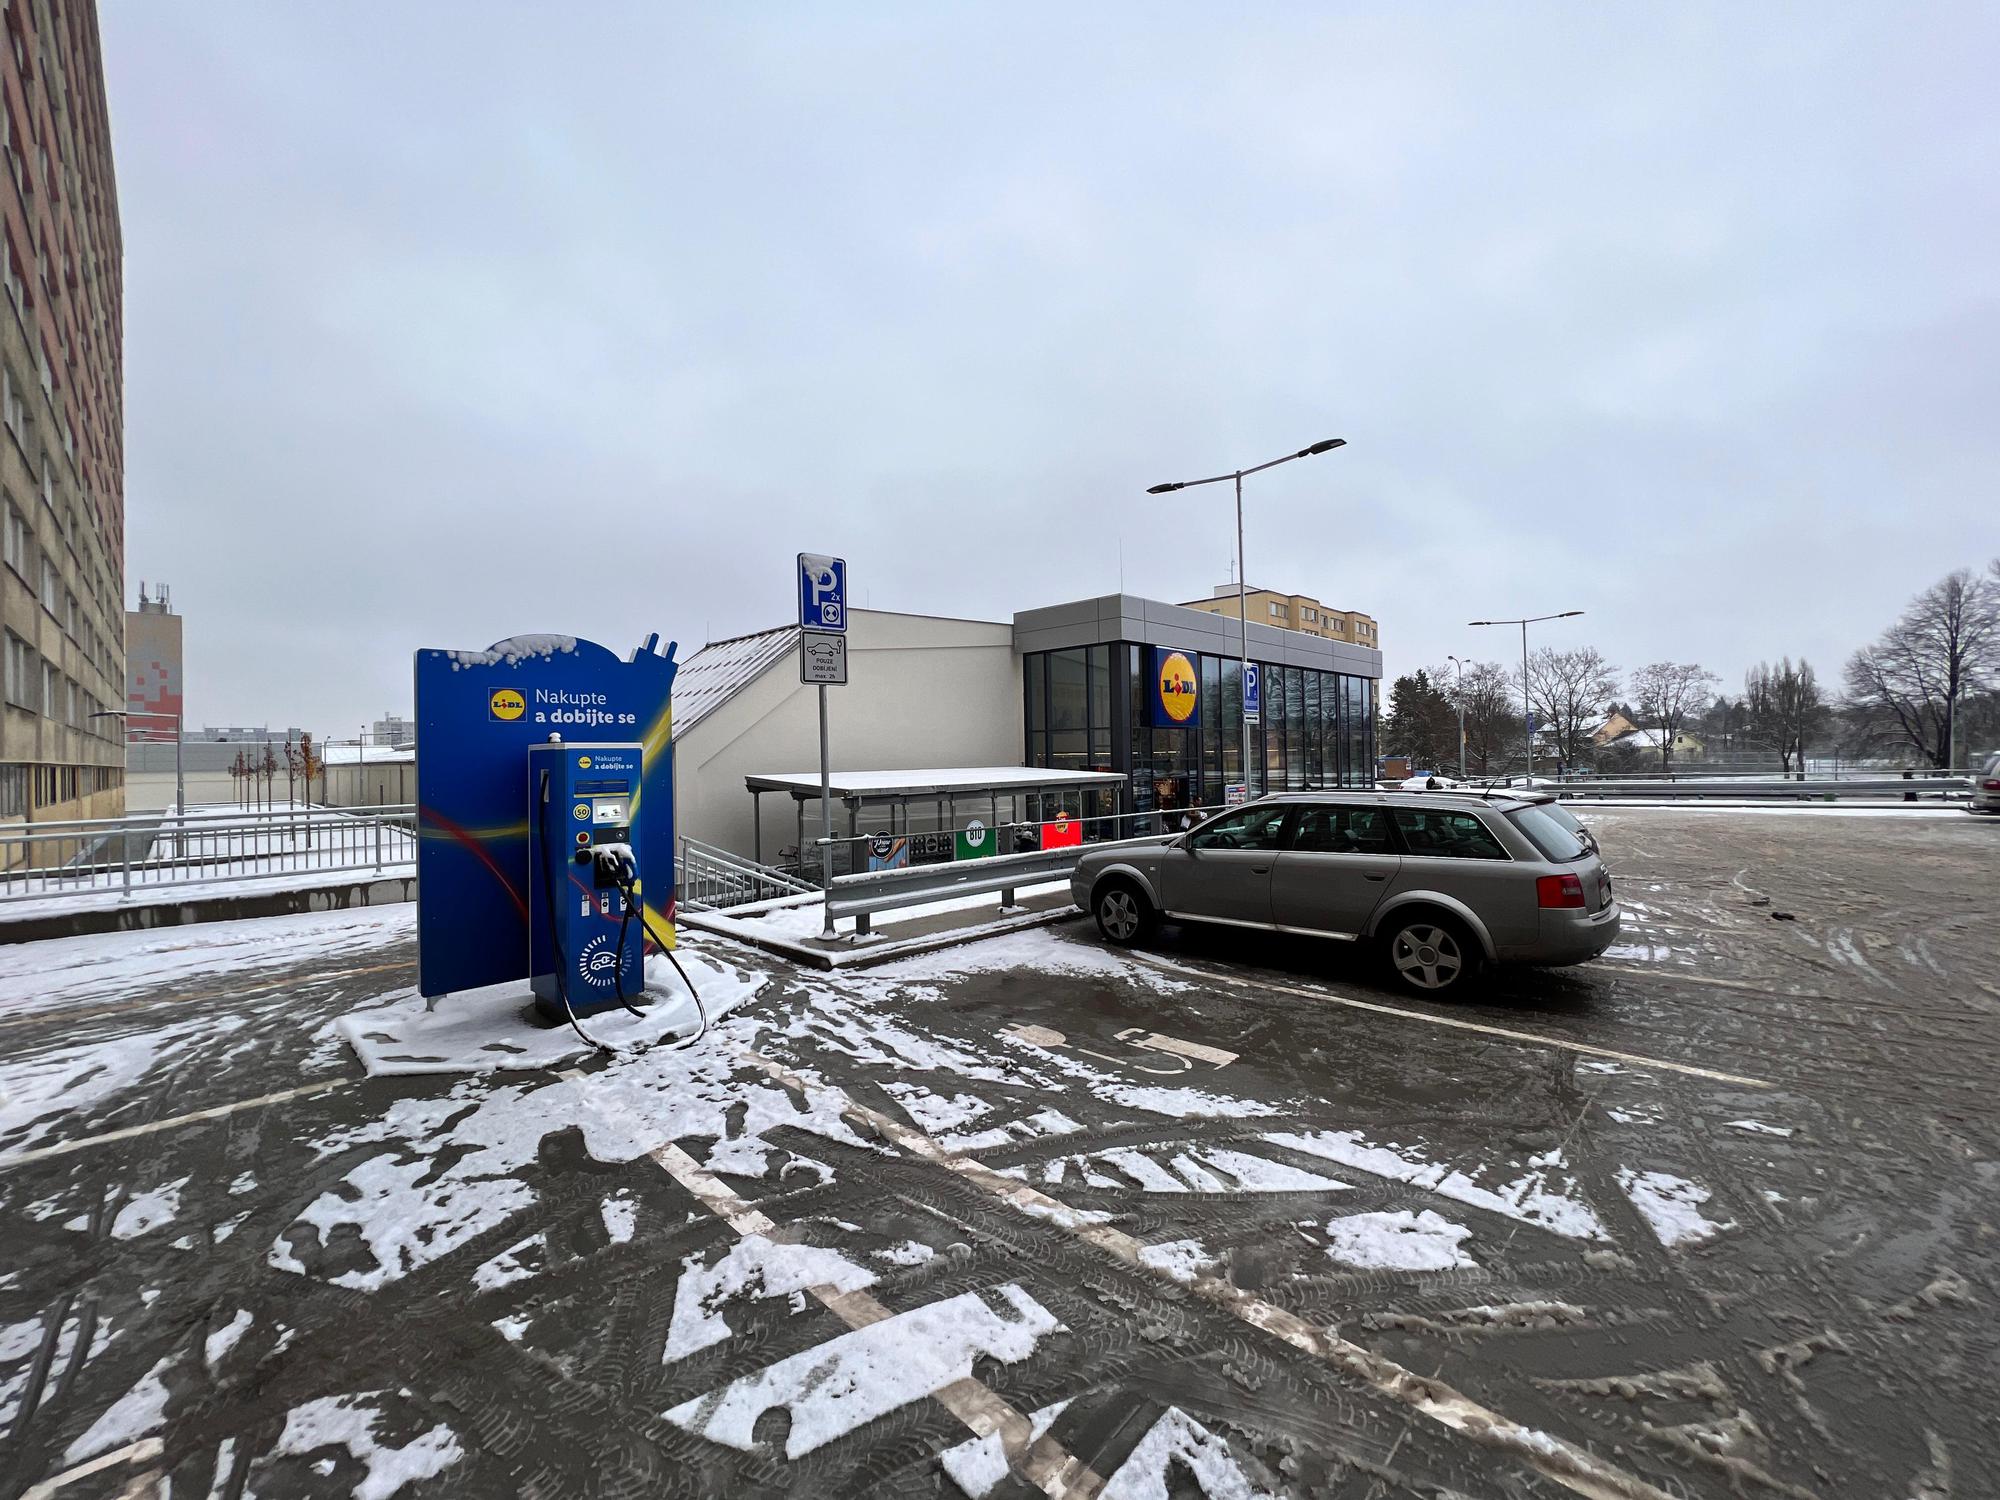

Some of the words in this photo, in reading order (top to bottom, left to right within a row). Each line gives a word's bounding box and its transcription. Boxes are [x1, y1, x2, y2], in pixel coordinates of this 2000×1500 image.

[811, 565, 838, 606] P
[830, 592, 841, 601] 2x
[536, 688, 606, 707] Nakupte
[535, 711, 547, 723] a
[550, 709, 614, 727] dobijte
[618, 713, 636, 724] se
[600, 763, 625, 771] dobijte
[577, 808, 587, 816] 50
[969, 827, 983, 841] BIO
